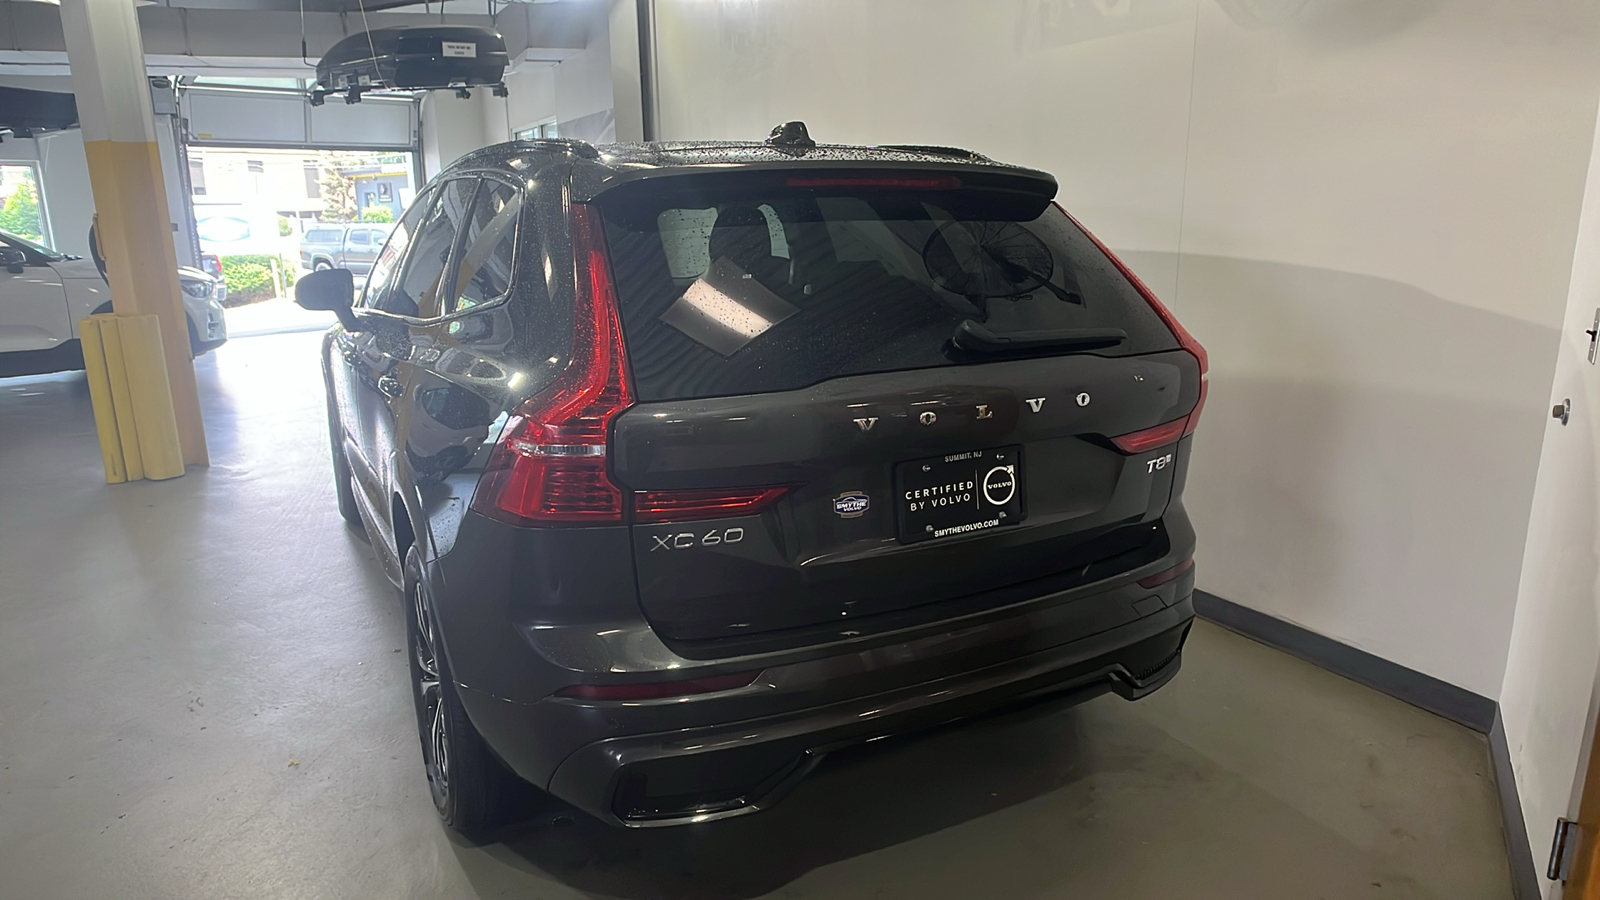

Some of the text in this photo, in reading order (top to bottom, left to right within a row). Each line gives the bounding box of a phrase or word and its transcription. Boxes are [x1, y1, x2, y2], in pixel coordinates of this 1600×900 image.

[853, 391, 1091, 432] VOLVO
[973, 451, 983, 460] NJ
[905, 480, 974, 500] CERTIFIED
[987, 480, 1012, 490] VOLVO
[836, 501, 867, 509] SMYTHE
[910, 492, 972, 512] BY VOLVO
[934, 518, 1000, 538] SMYTHEVOLVO.COM
